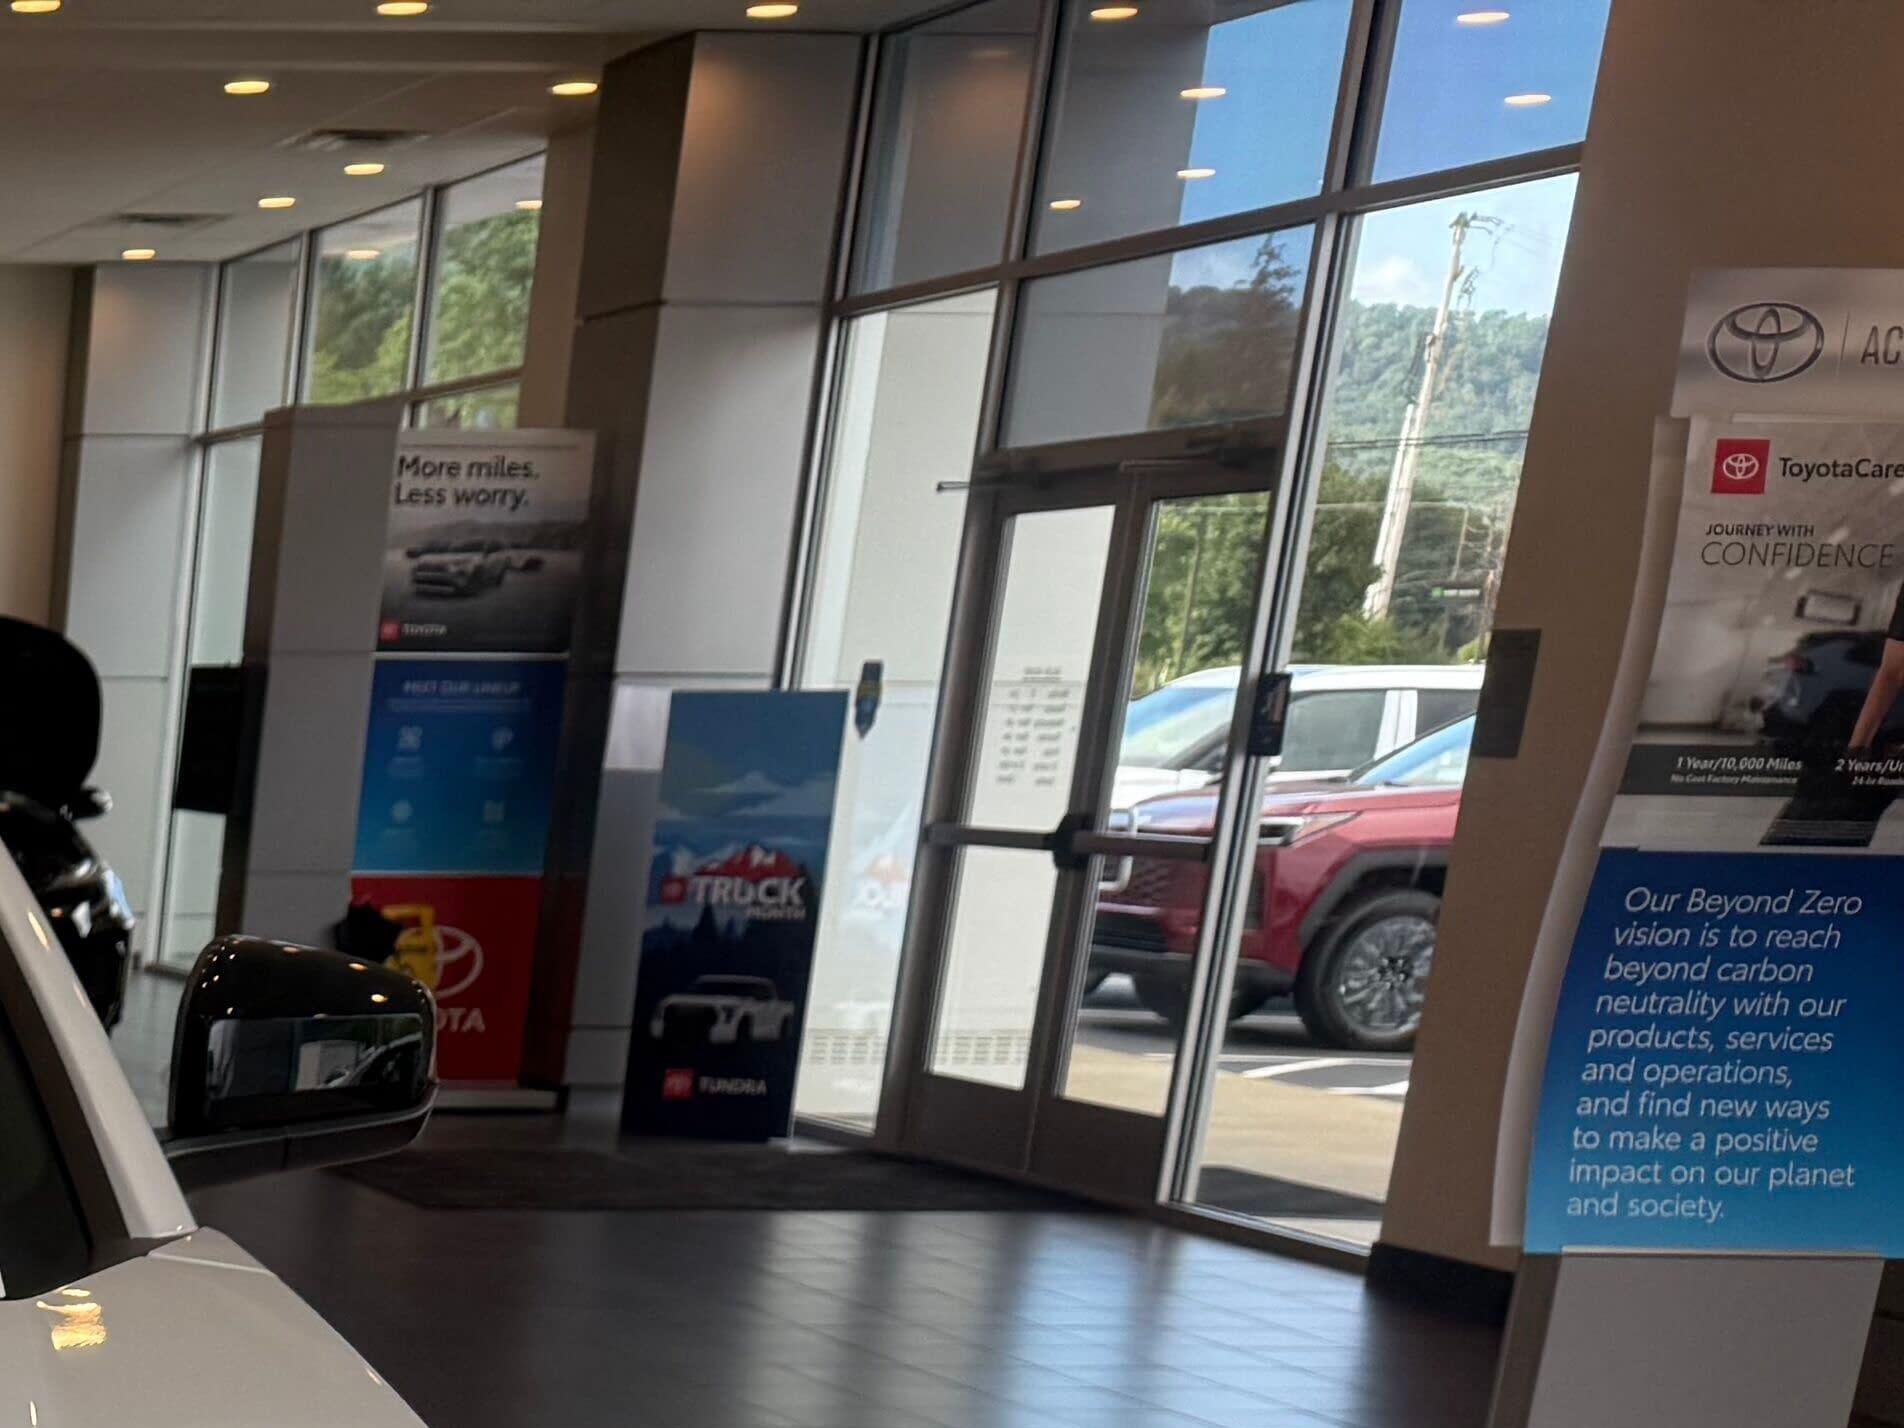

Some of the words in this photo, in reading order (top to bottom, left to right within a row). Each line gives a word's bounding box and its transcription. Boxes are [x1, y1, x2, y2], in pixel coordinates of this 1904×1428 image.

[397, 455, 462, 478] More
[467, 455, 540, 480] miles.
[1779, 457, 1904, 482] ToyotaCare
[394, 484, 448, 505] Less
[453, 487, 529, 512] worry.
[1705, 523, 1774, 537] JOURNEY
[1776, 524, 1815, 537] WITH
[1701, 541, 1896, 568] CONFIDENCE
[1676, 756, 1684, 769] 1
[1766, 757, 1804, 771] Miles
[1834, 758, 1845, 772] 2
[692, 876, 806, 906] TRUCK
[1624, 886, 1682, 914] Our
[1686, 888, 1795, 920] Beyond
[1798, 889, 1863, 915] Zero
[1614, 921, 1691, 948] vision
[1699, 922, 1721, 948] is
[1729, 925, 1758, 948] to
[1765, 923, 1842, 949] reach
[1603, 953, 1712, 986] beyond
[1716, 957, 1814, 983] carbon
[1595, 989, 1728, 1023] neutrality
[1733, 991, 1790, 1017] with
[1798, 997, 1848, 1017] our
[1586, 1022, 1714, 1053] products,
[1725, 1026, 1834, 1052] services
[698, 1076, 768, 1097] TUNDRA
[1581, 1056, 1636, 1083] and
[1642, 1059, 1793, 1088] operations,
[1576, 1090, 1630, 1117] and
[1637, 1090, 1692, 1117] find
[1700, 1098, 1758, 1118] new
[1765, 1098, 1832, 1125] ways
[1572, 1126, 1600, 1150] to
[1608, 1124, 1682, 1151] make
[1690, 1132, 1706, 1151] a
[1715, 1127, 1819, 1157] positive
[1568, 1157, 1662, 1189] impact
[1670, 1164, 1706, 1185] on
[1714, 1164, 1761, 1185] our
[1768, 1160, 1856, 1191] planet
[1567, 1191, 1619, 1217] and
[1627, 1193, 1725, 1224] society.
